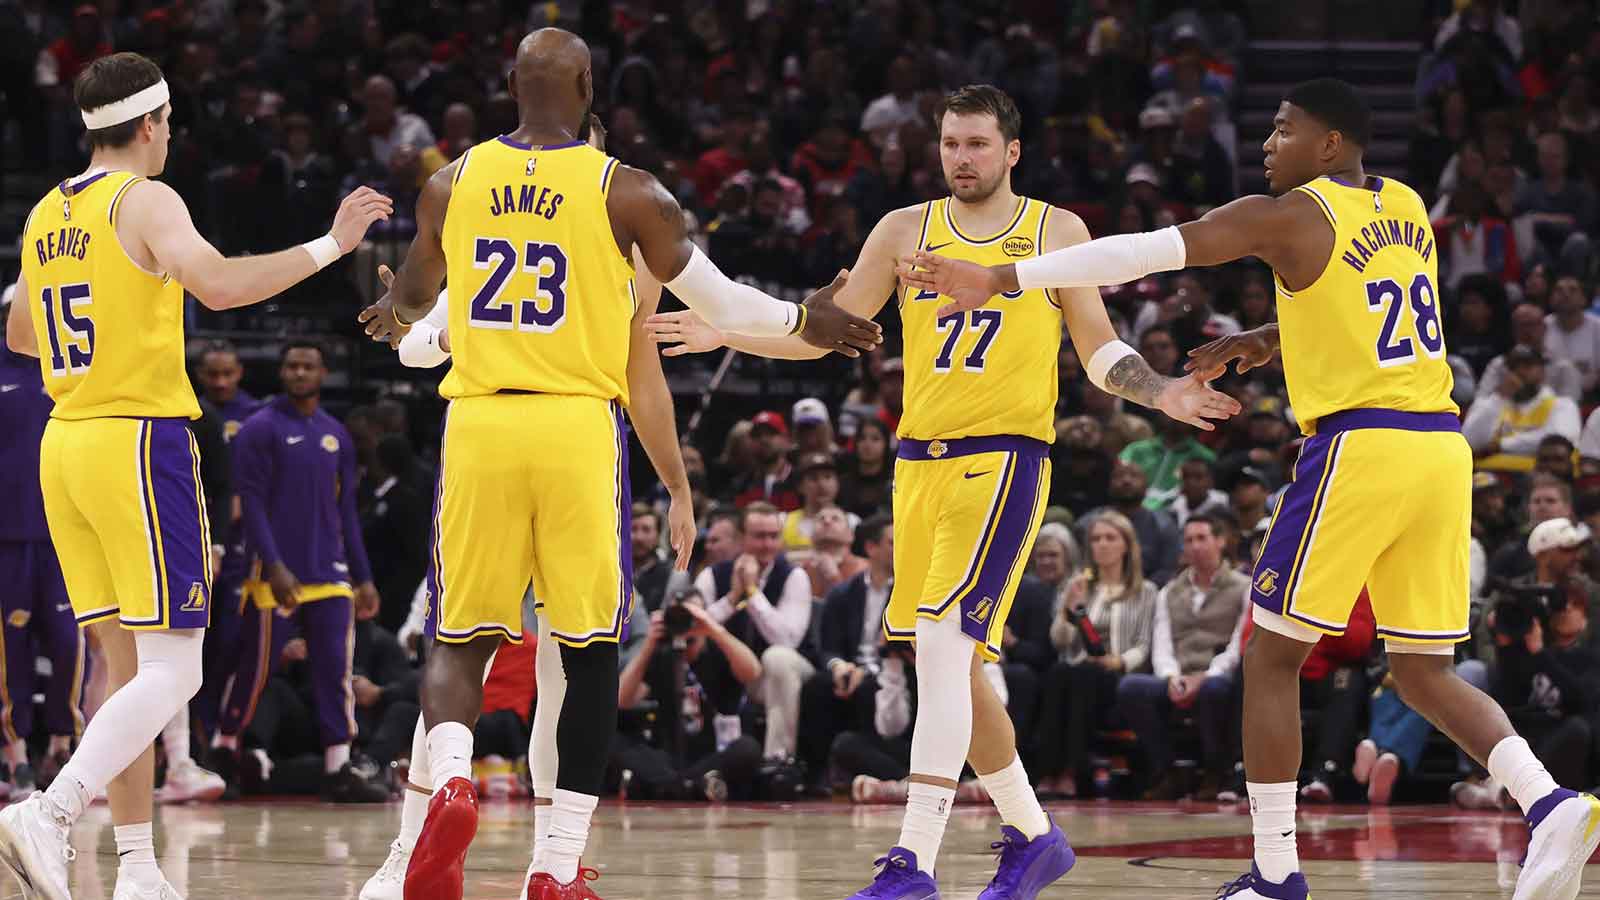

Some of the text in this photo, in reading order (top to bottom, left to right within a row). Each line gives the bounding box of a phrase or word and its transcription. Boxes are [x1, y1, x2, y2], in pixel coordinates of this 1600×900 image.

[490, 184, 564, 220] JAMES
[36, 227, 90, 266] REAVES
[1005, 241, 1032, 251] bibigo
[1341, 219, 1433, 273] HACHIMURA
[470, 237, 568, 332] 23
[42, 282, 95, 375] 15
[934, 309, 1003, 373] 77
[1365, 273, 1443, 367] 28
